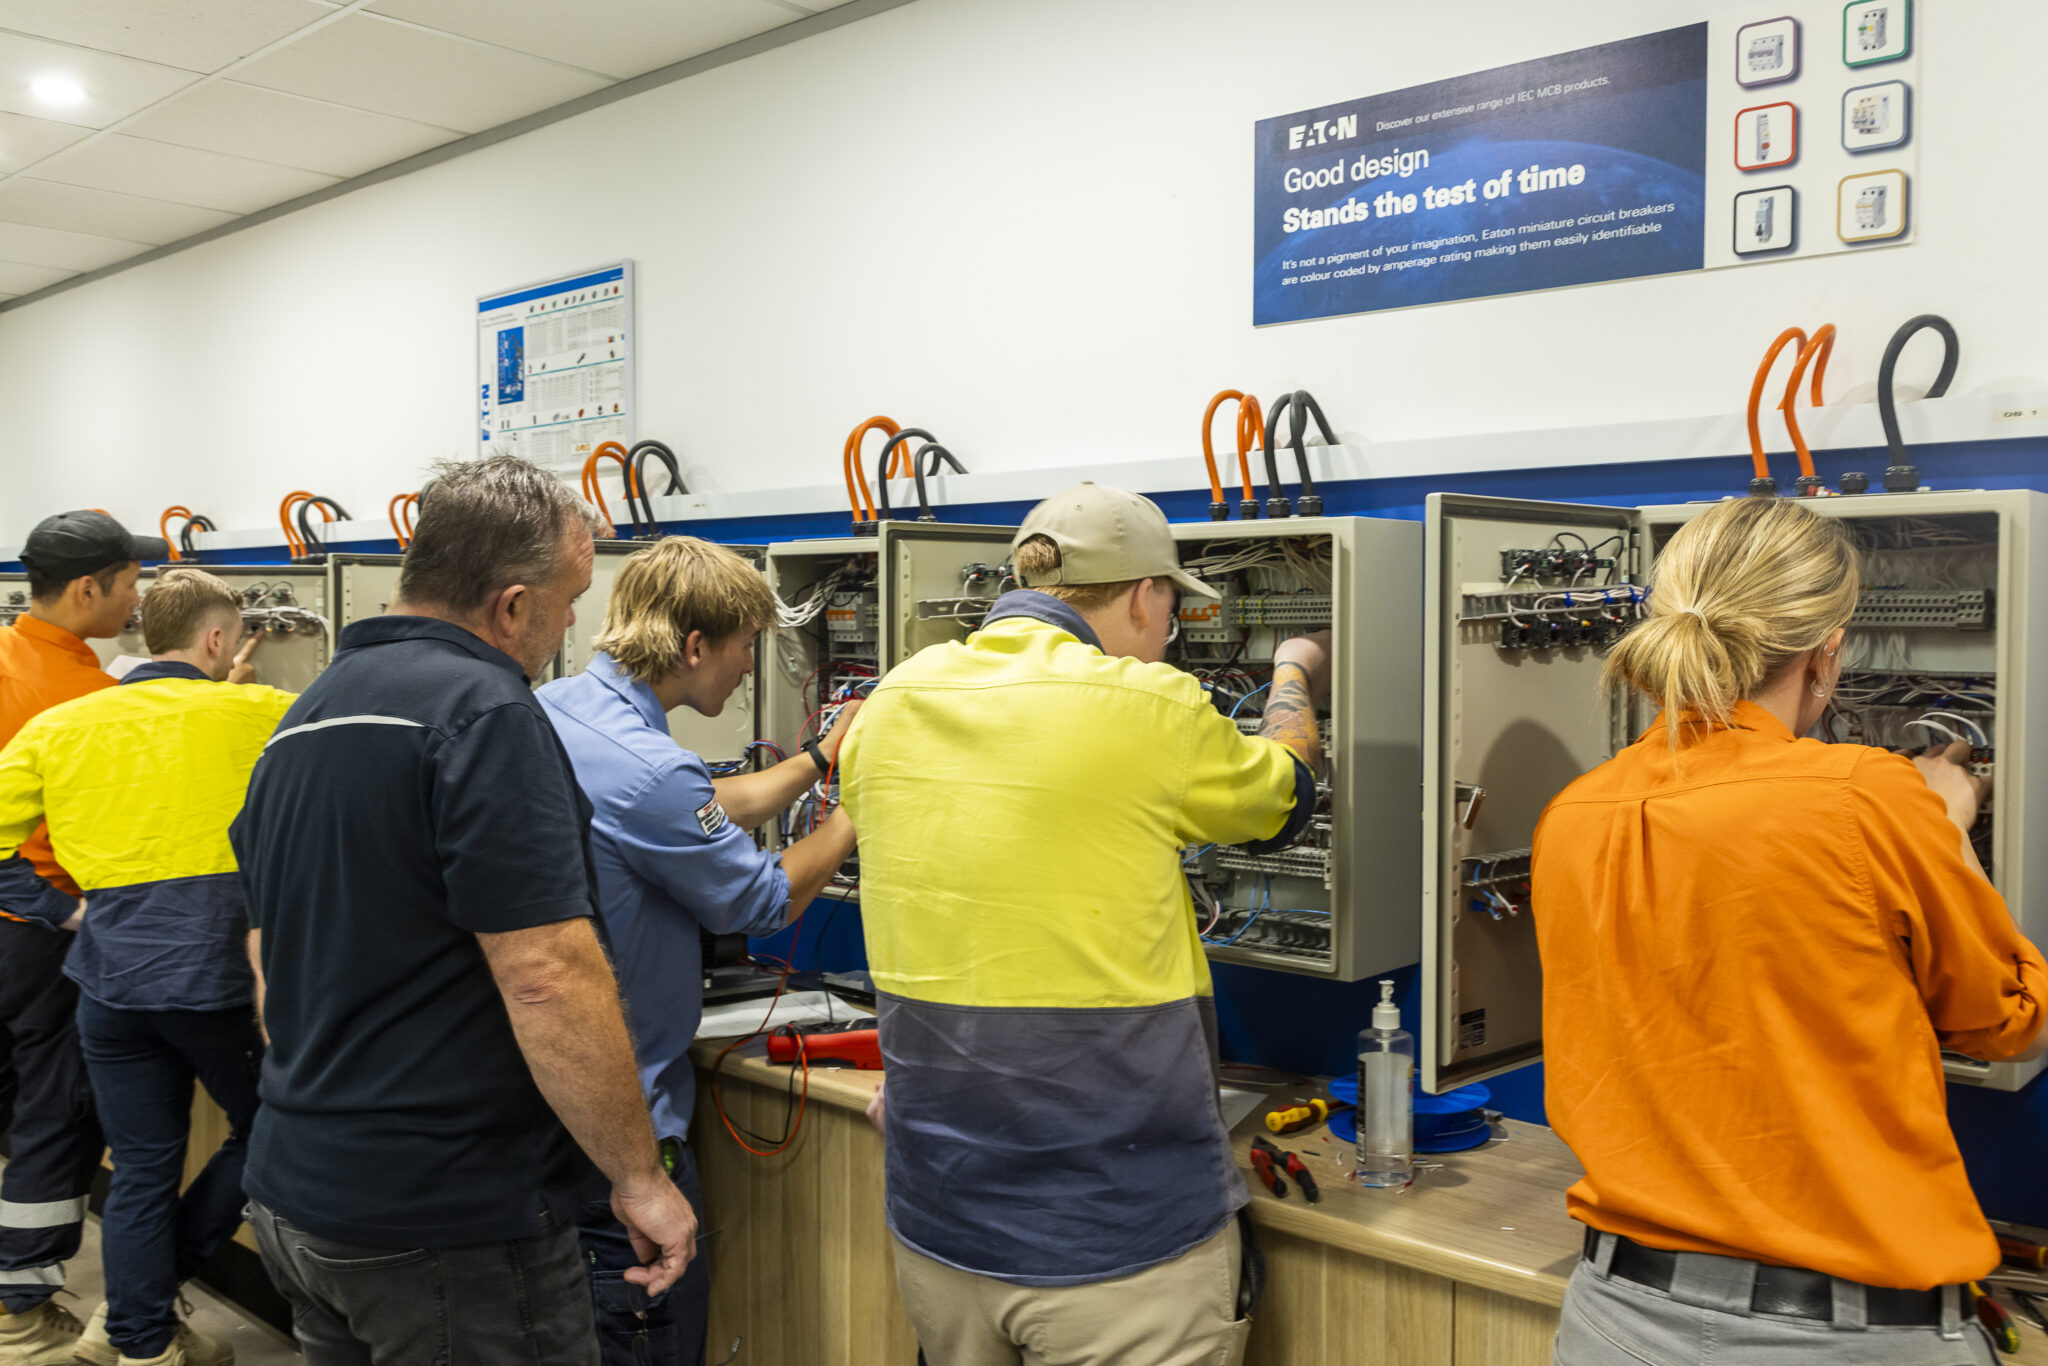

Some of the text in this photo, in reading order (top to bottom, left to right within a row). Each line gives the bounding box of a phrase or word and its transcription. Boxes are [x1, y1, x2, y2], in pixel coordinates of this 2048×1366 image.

[1289, 114, 1357, 150] EATON
[1376, 76, 1610, 132] Discover our extensive range of IEC MCB products.
[1282, 164, 1586, 233] Stands the test of time
[1284, 148, 1429, 193] Good design
[1281, 222, 1662, 286] are colour coded by amperage rating making them easily identifiable
[1282, 202, 1676, 270] It's not a pigment of your imagination, Eaton miniature circuit breakers
